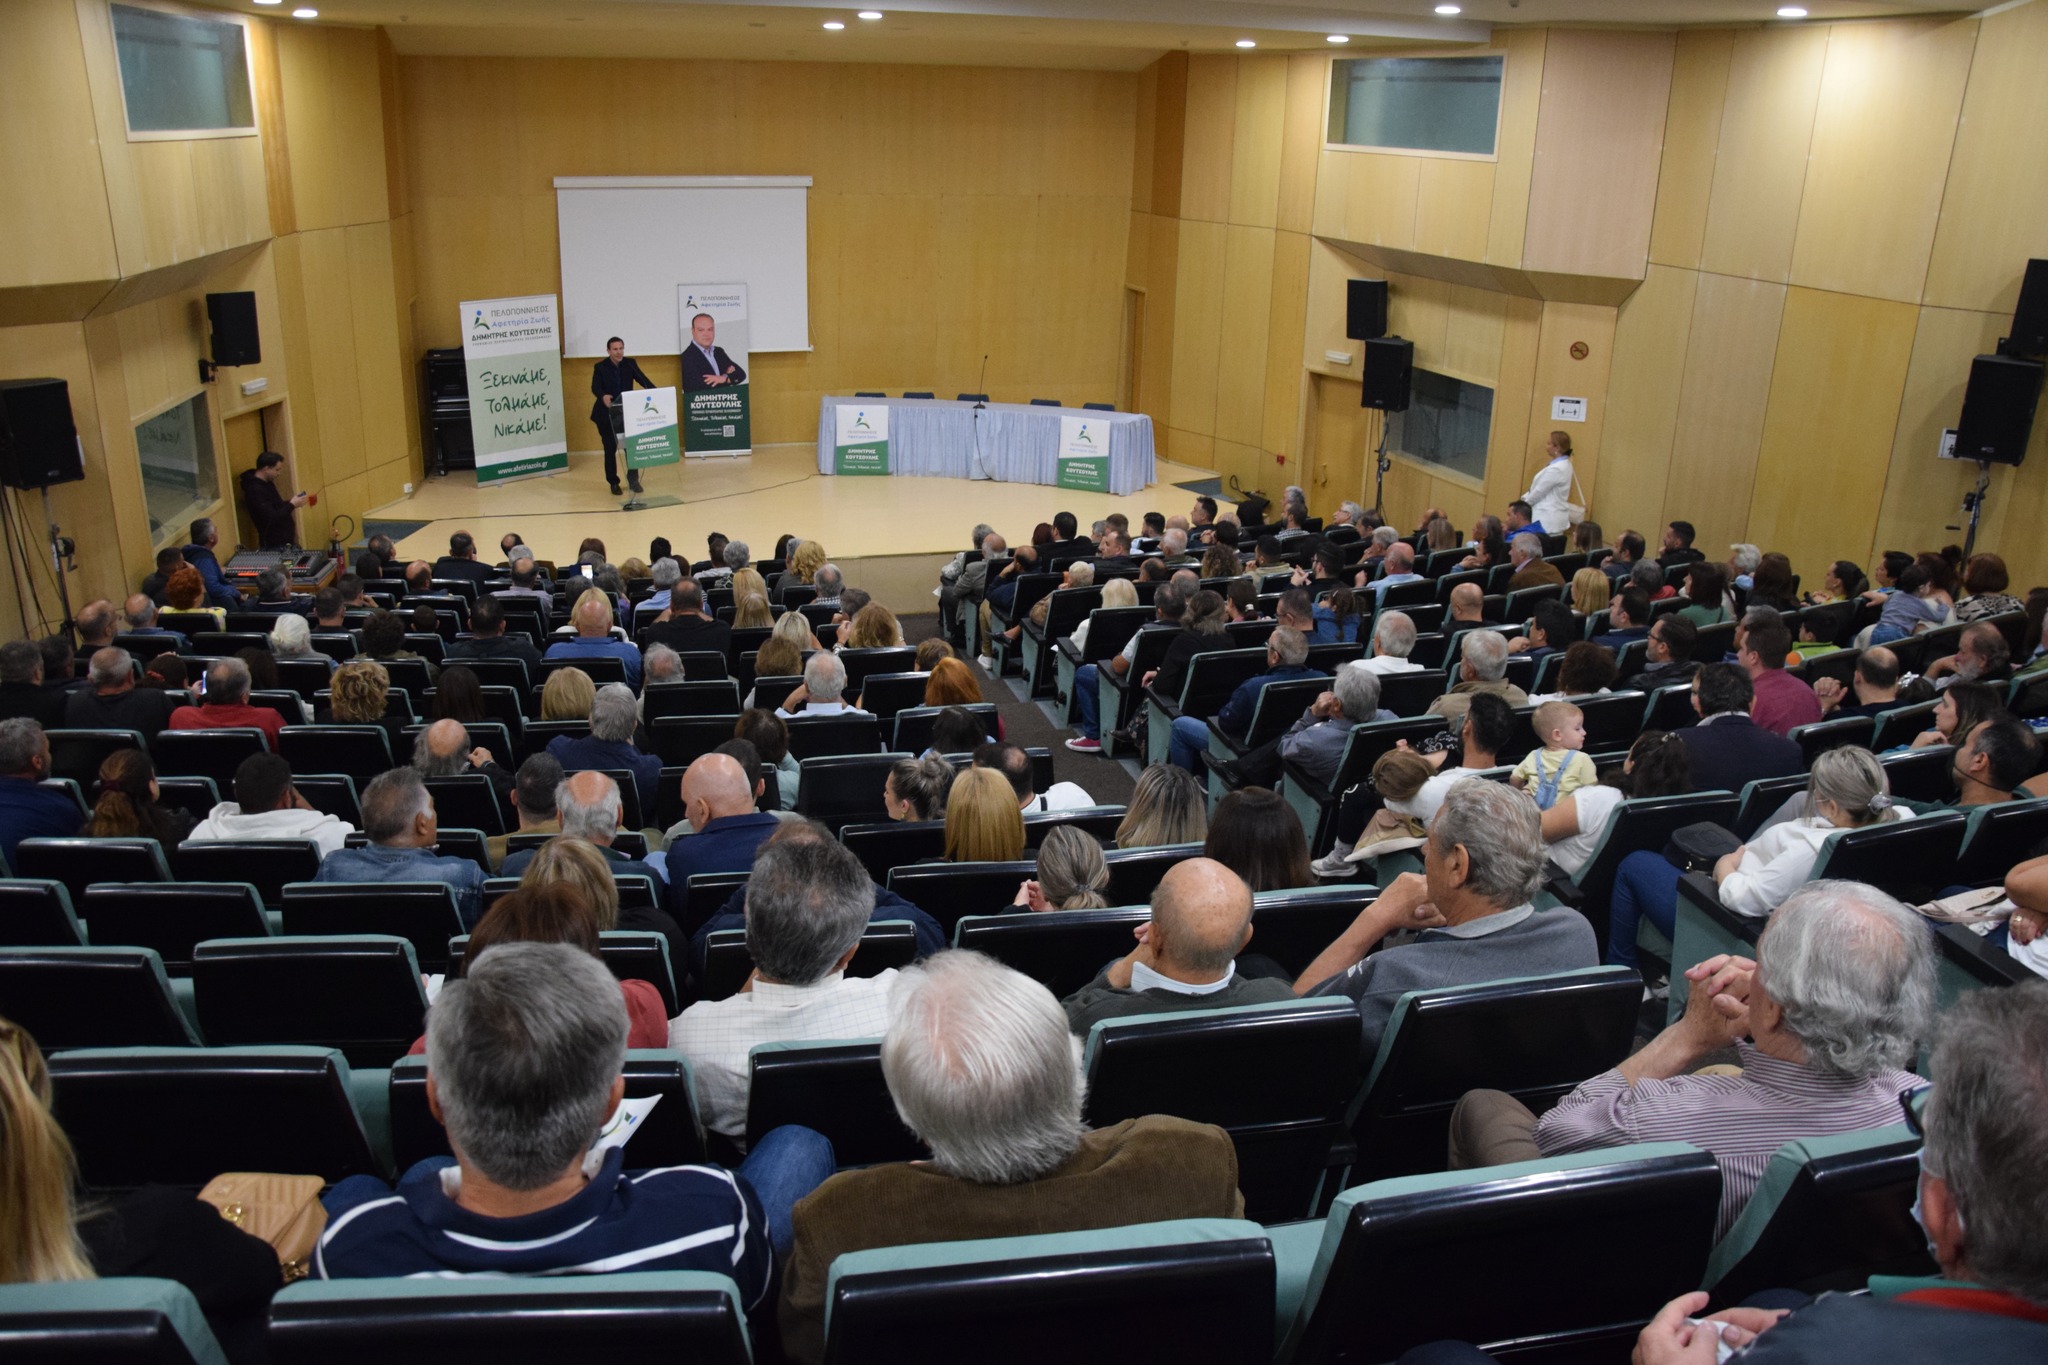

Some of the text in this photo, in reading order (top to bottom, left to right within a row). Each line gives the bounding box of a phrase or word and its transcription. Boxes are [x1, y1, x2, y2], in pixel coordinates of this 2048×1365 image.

[491, 305, 549, 317] ΠΕΛΟΠΟΝΝΗΣΟΣ
[491, 316, 551, 328] Αφετηρία Ζωής
[472, 331, 508, 341] ΔΗΜΗΤΡΗΣ
[509, 327, 552, 337] ΚΟΥΤΣΟΥΛΗΣ
[480, 368, 550, 390] Ξεκινάμε,
[484, 392, 550, 414] Τολμάμε,
[694, 394, 738, 402] ΔΗΜΗΤΡΗΣ
[690, 401, 742, 409] ΚΟΥΤΣΟΥΛΗΣ
[494, 413, 547, 438] Νικάμε!
[497, 462, 548, 475] www.afetiriazois.gr
